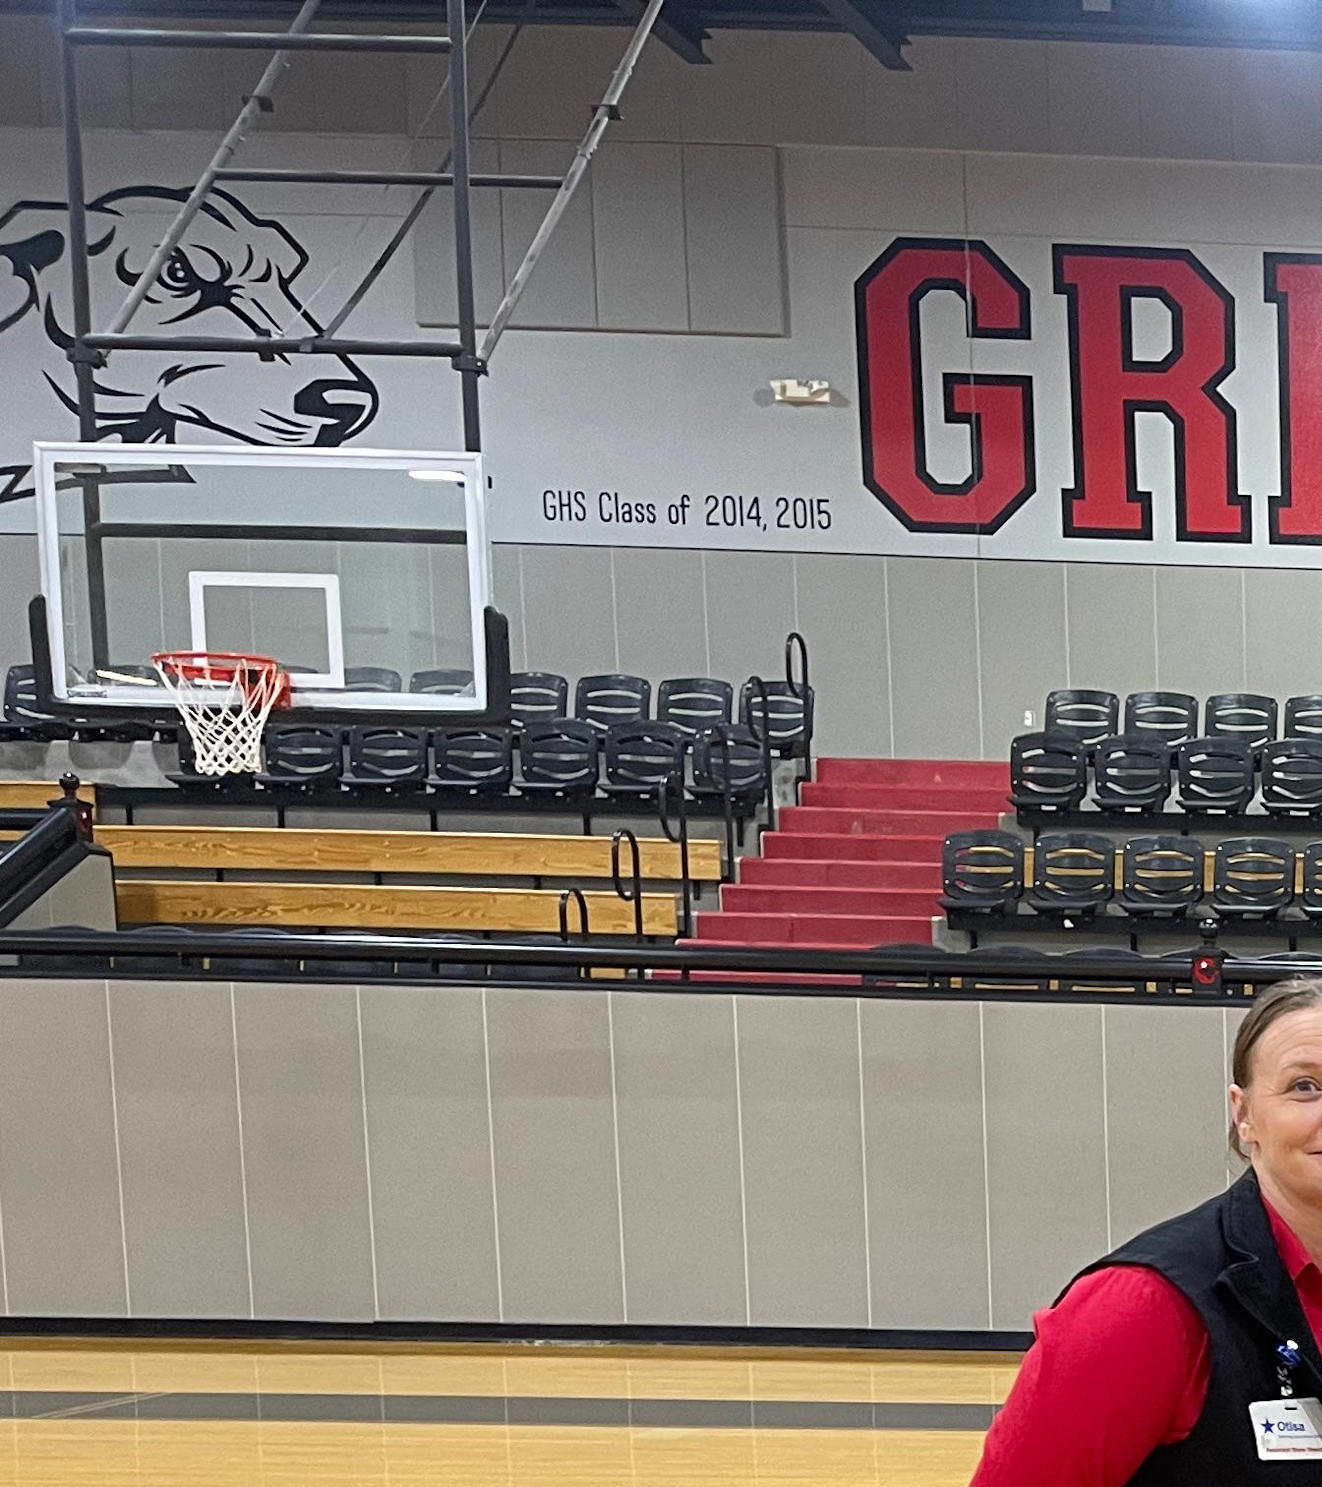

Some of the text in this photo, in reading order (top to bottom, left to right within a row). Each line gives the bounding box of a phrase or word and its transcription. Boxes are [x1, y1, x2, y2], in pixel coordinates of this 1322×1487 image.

[543, 490, 832, 532] GHS Class of 2014, 2015
